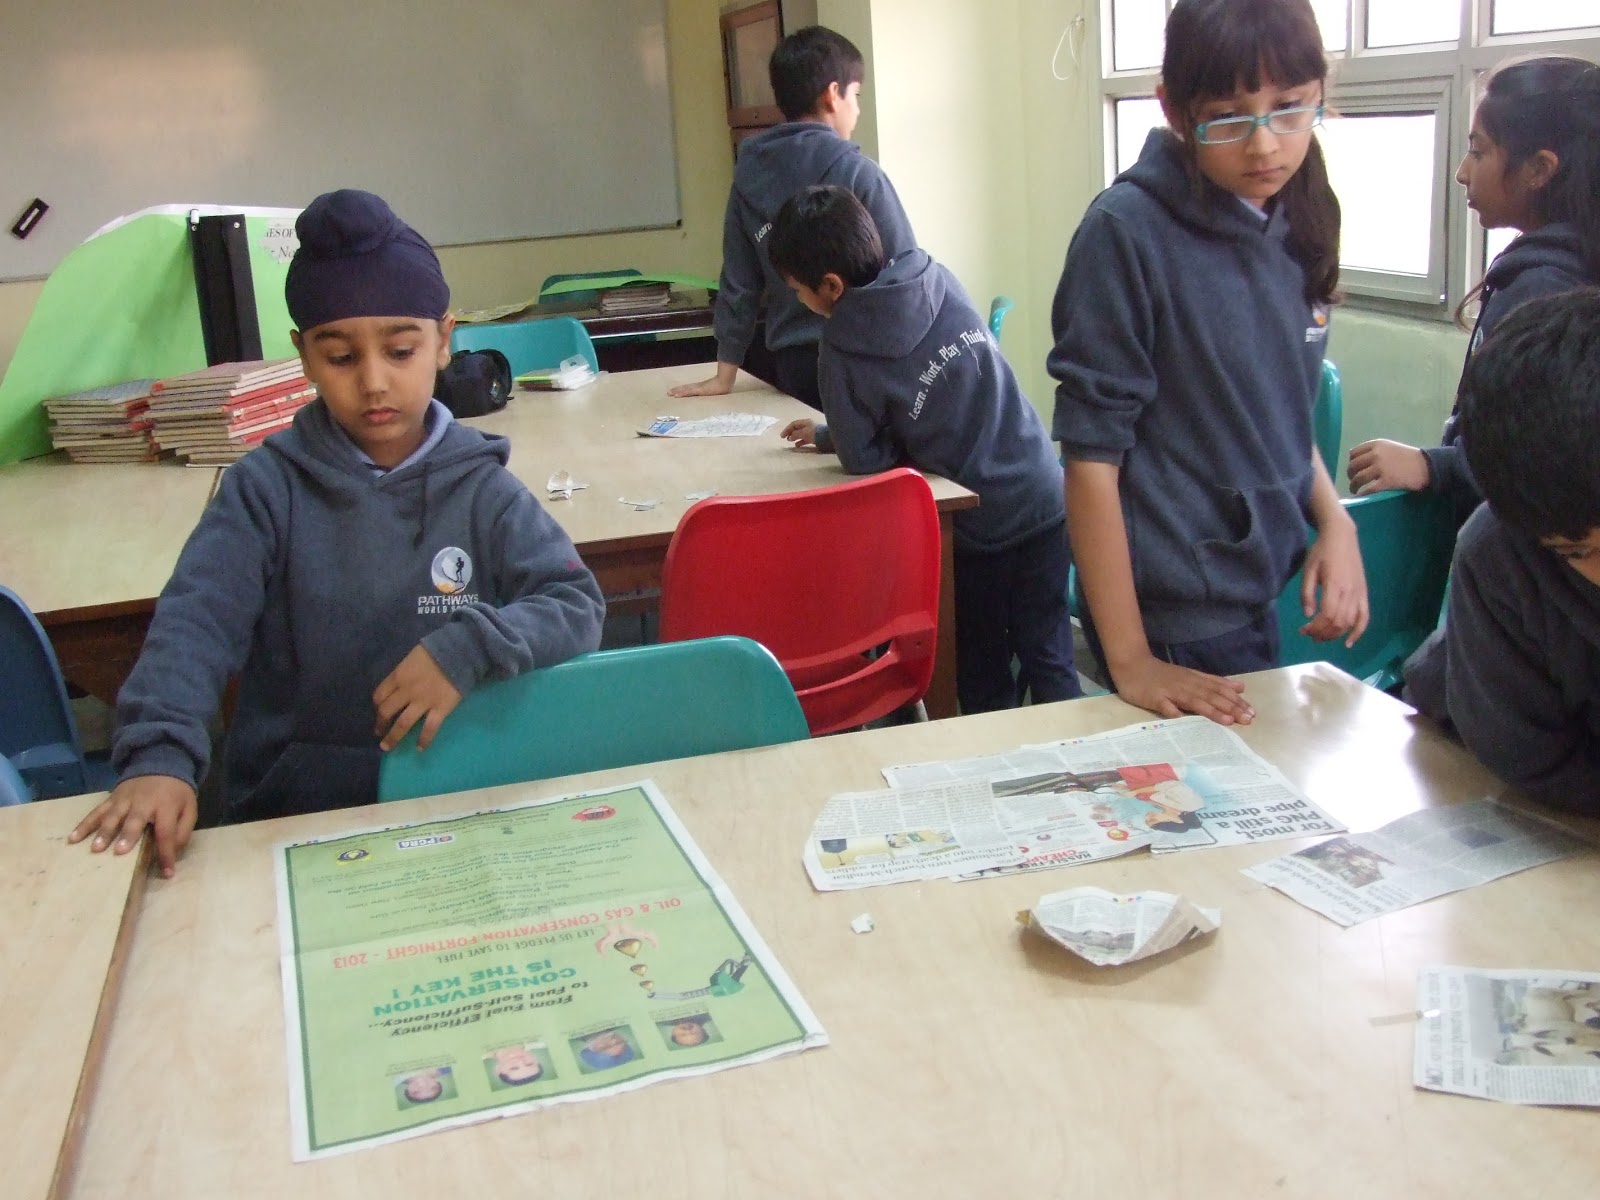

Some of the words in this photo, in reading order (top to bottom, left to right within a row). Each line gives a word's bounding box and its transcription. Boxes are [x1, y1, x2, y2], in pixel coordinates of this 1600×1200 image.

[418, 594, 479, 606] PATHWAYS
[417, 605, 448, 615] WORLD
[1264, 799, 1308, 813] pipe
[1195, 807, 1262, 821] dream
[1274, 811, 1323, 825] PNG
[1215, 820, 1230, 830] a
[1235, 816, 1273, 831] still
[1300, 820, 1334, 833] For
[654, 898, 681, 910] OIL
[604, 907, 634, 920] GAS
[482, 912, 600, 942] CONSERVATION
[513, 936, 556, 950] PLEDGE
[558, 933, 573, 943] US
[386, 935, 478, 960] FORTNIGHT
[467, 944, 492, 958] SAVE
[332, 952, 368, 969] 2013
[436, 952, 463, 964] FUEL
[469, 964, 518, 982] THE
[525, 959, 552, 973] IS
[373, 967, 577, 1017] CONSERVATION
[410, 976, 461, 997] KEY
[530, 986, 566, 1000] Fuel
[529, 995, 574, 1010] From
[487, 1002, 524, 1018] Fuel
[391, 1013, 481, 1037] Efficiency
